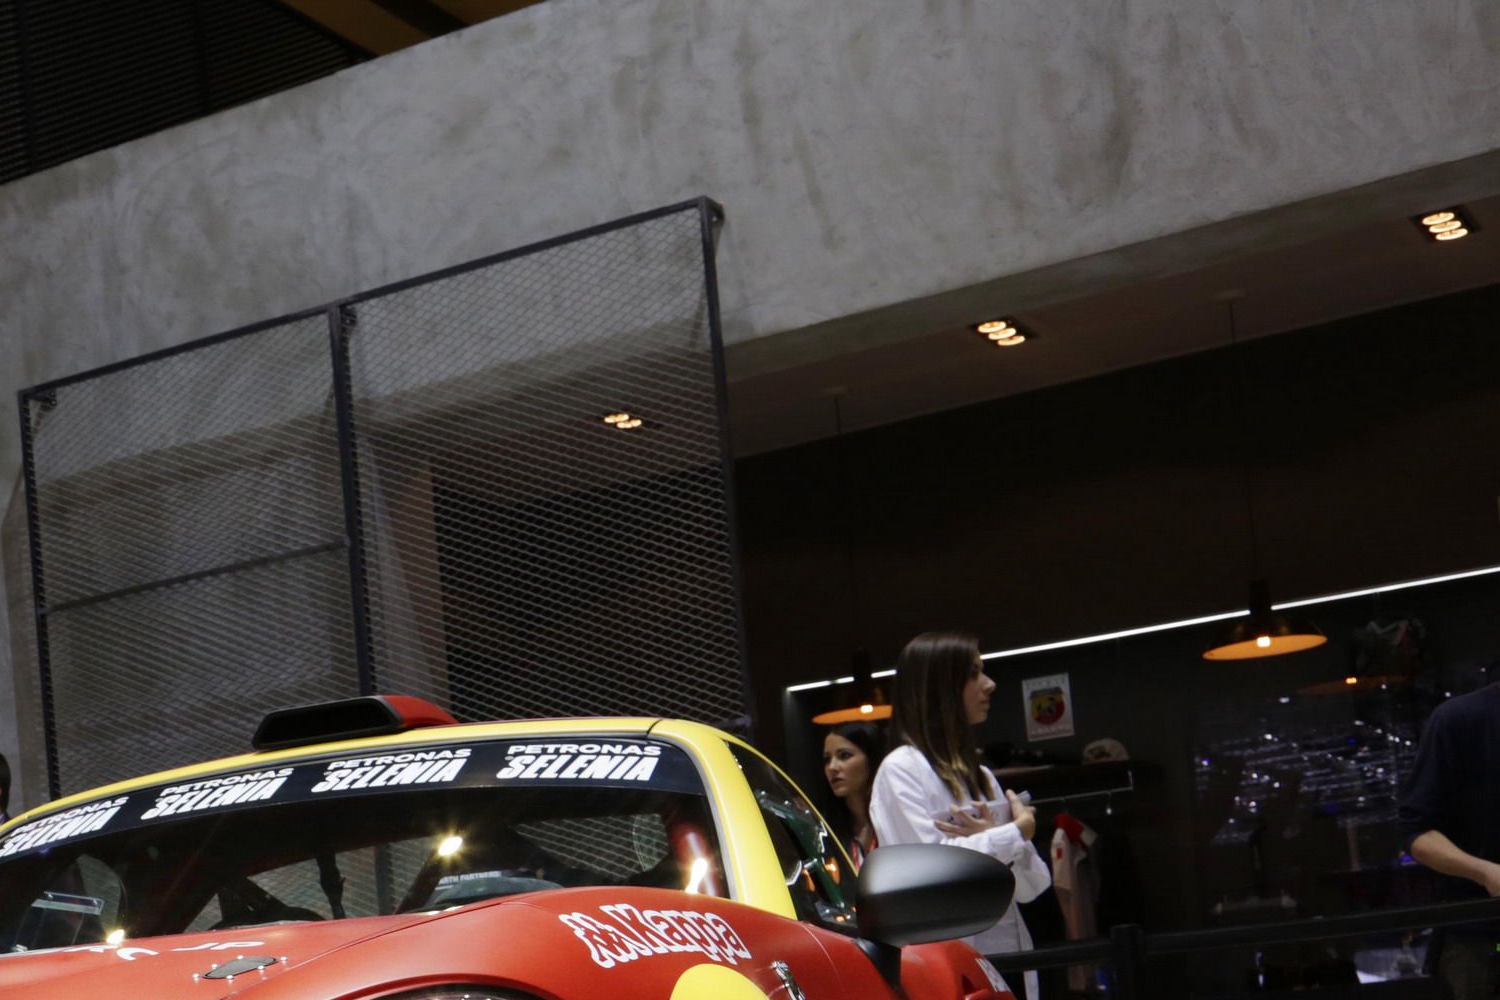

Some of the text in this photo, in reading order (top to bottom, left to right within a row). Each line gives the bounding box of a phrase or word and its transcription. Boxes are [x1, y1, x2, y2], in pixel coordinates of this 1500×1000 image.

[327, 748, 472, 771] PETRONAS
[506, 743, 661, 756] PETRONAS
[159, 767, 294, 798] PETRONAS
[311, 757, 470, 793] SELENIA
[496, 754, 659, 782] SELENIA
[140, 776, 289, 820] SELENIA
[599, 903, 752, 965] Kappa
